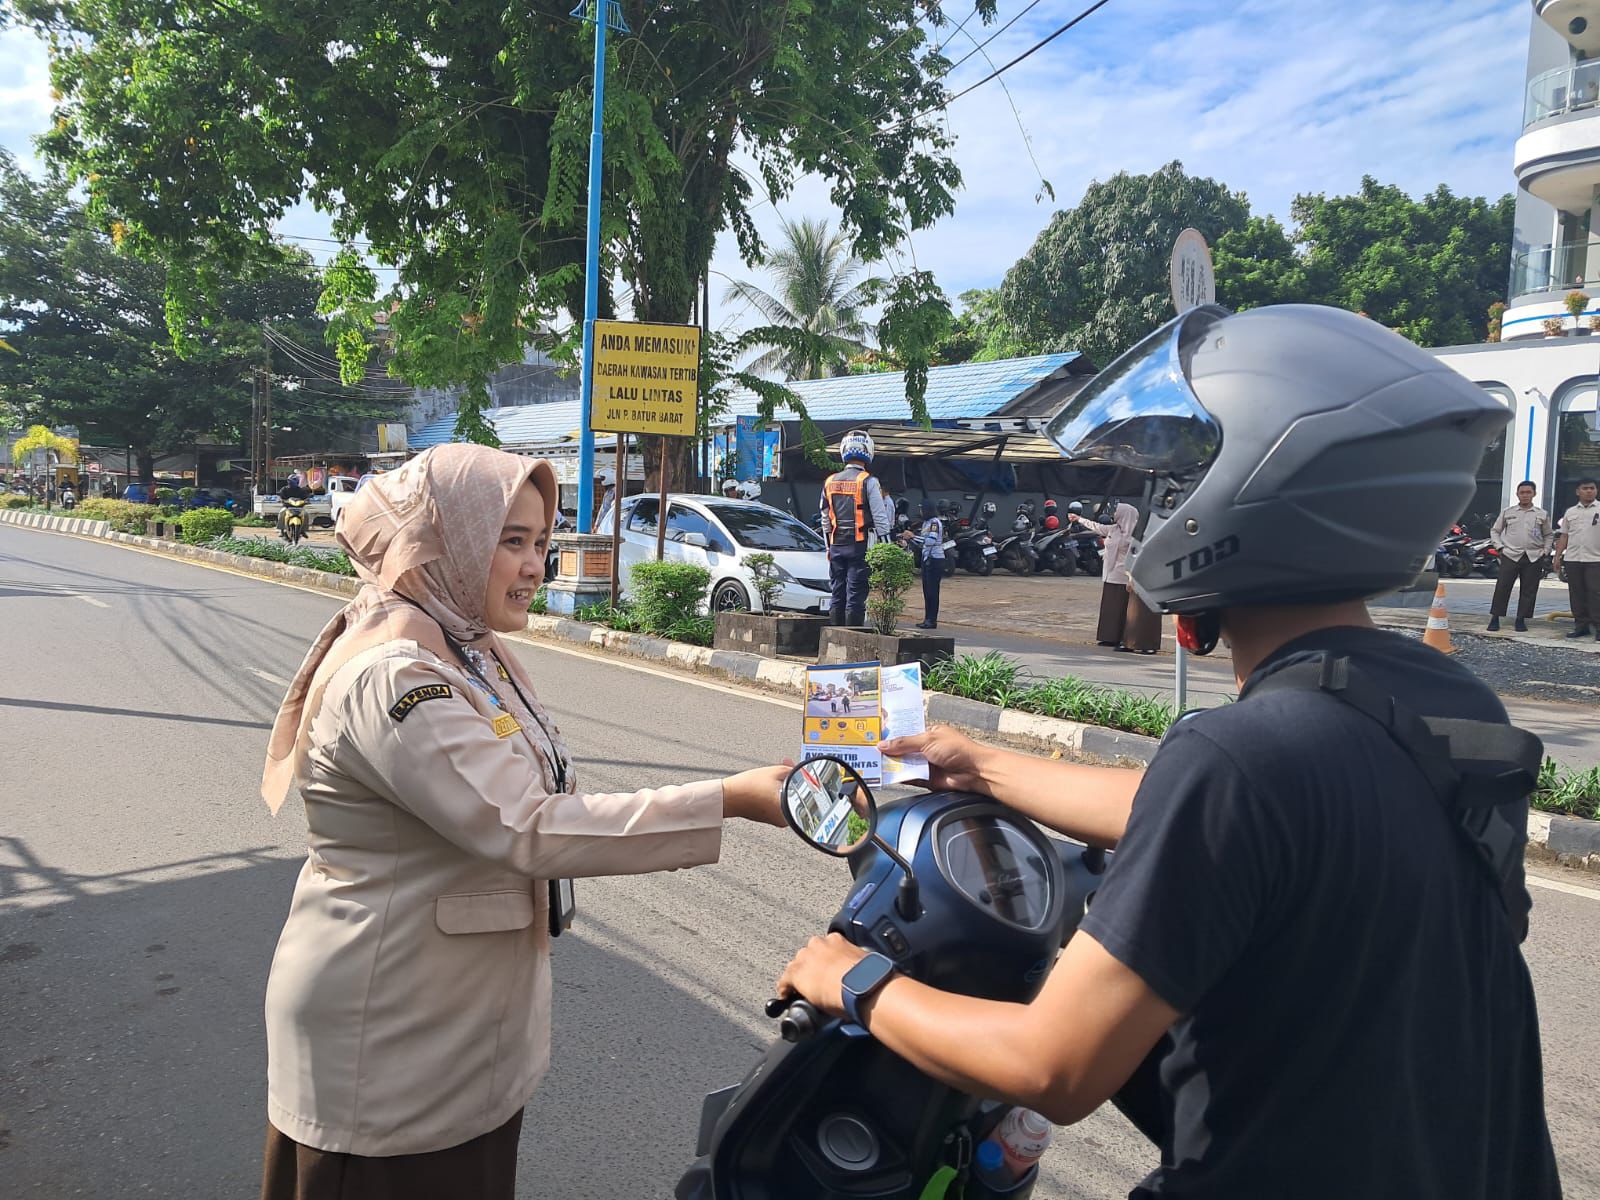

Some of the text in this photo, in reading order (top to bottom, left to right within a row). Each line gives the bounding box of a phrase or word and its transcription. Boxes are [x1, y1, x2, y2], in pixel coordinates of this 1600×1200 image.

[601, 334, 630, 351] ANDA
[597, 362, 696, 381] DAERAH KAWASAN TERTIB
[609, 386, 683, 403] LALU LINTAS
[607, 408, 621, 420] JLN
[632, 410, 656, 422] BATUR
[659, 412, 683, 424] BARAT
